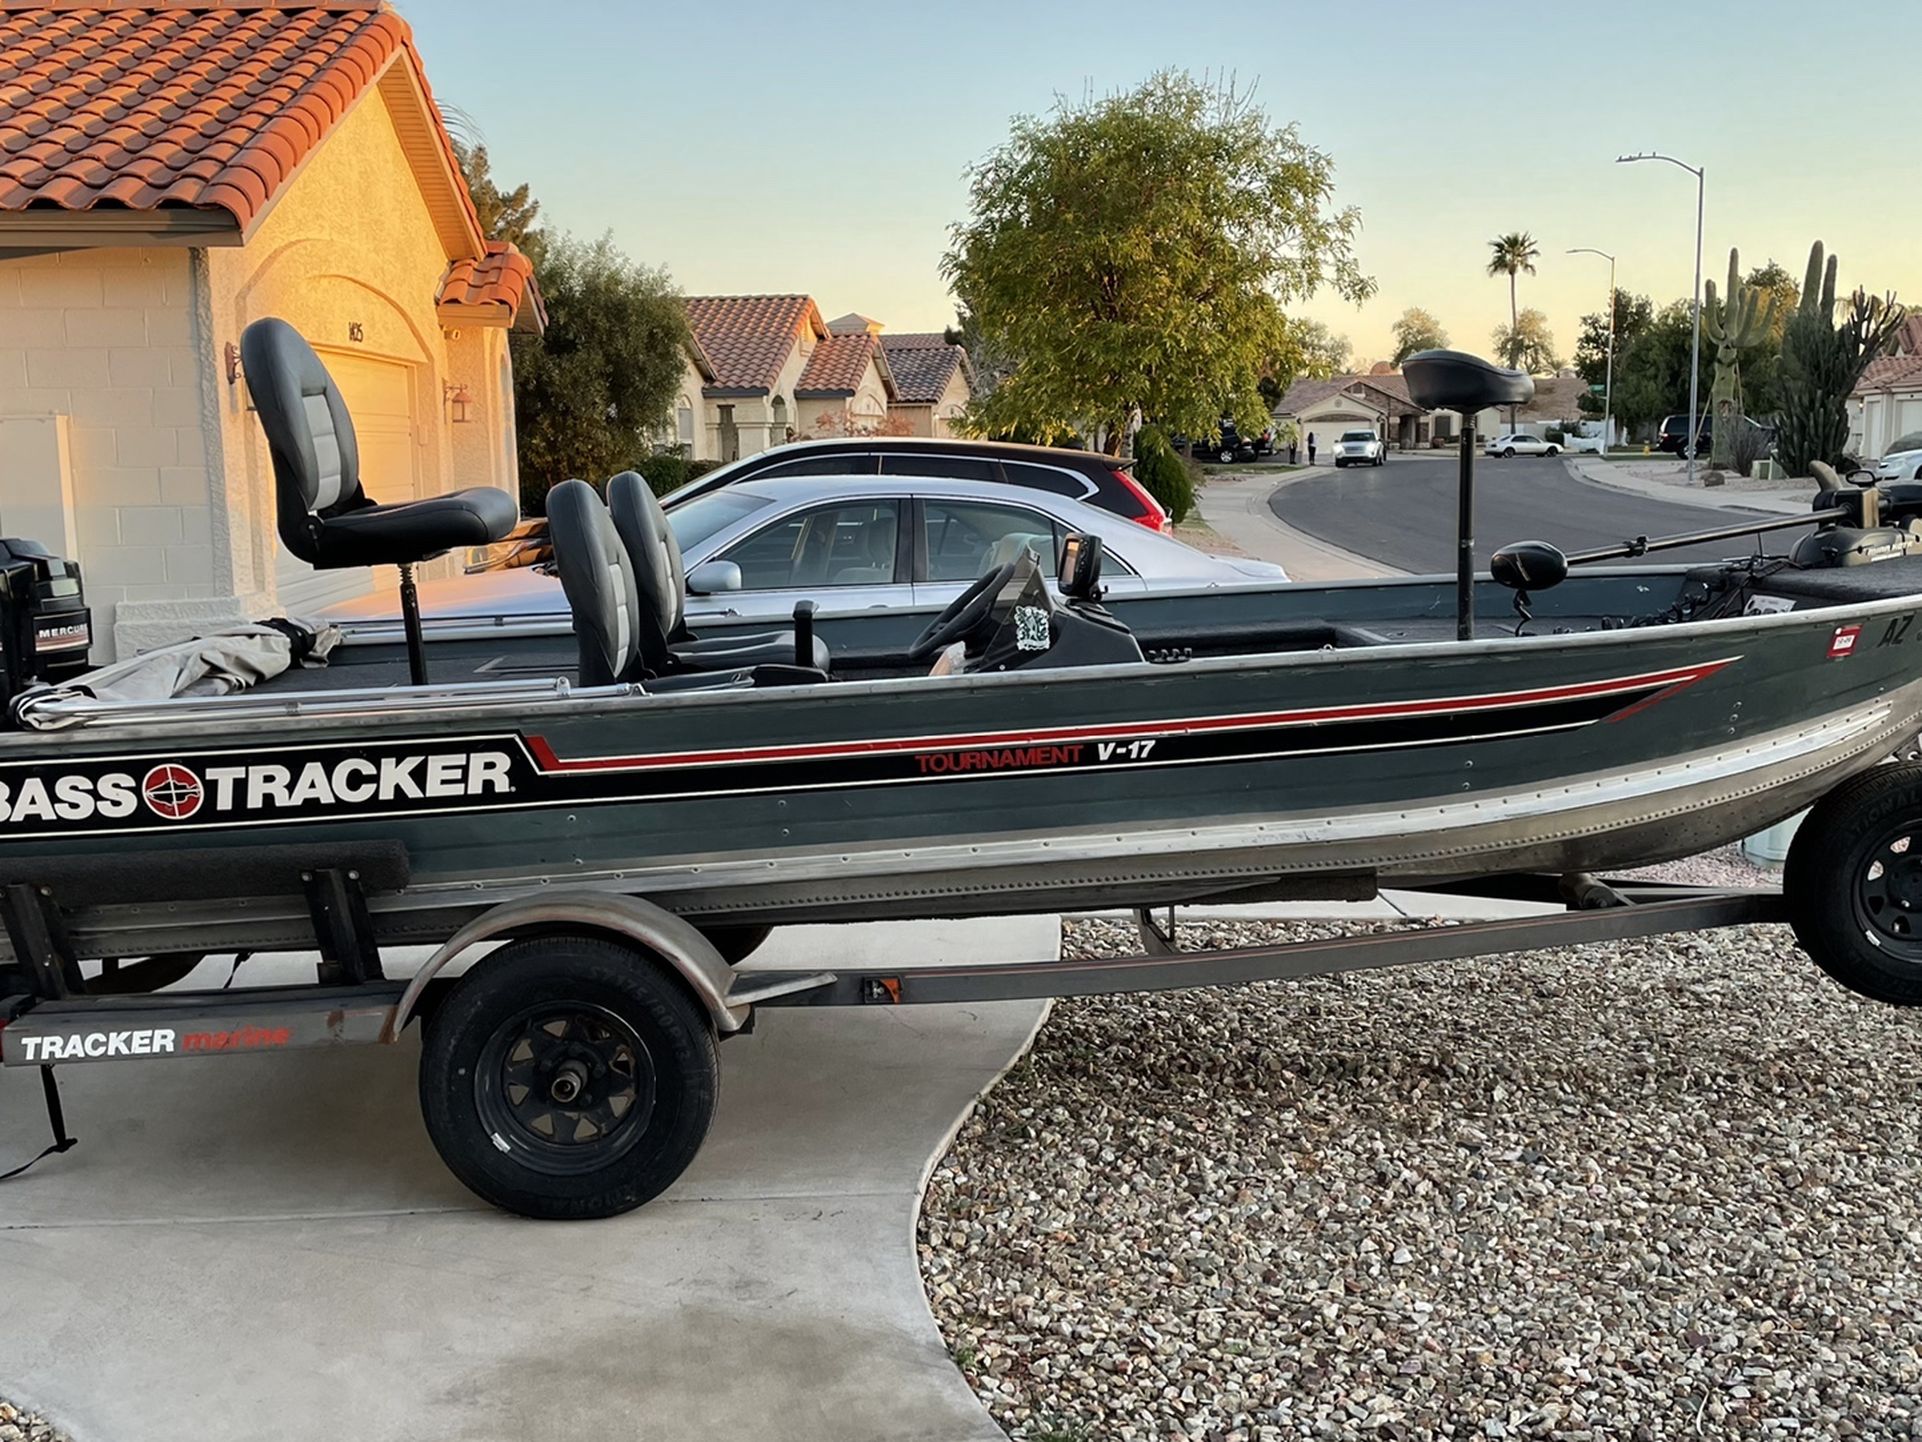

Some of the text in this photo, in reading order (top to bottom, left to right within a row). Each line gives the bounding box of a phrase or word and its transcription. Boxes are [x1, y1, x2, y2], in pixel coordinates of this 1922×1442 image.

[1878, 616, 1915, 648] AZ
[916, 740, 1156, 773] TOURNAMENT V-17
[205, 752, 515, 811] TRACKER
[21, 1026, 290, 1060] TRACKER marine
